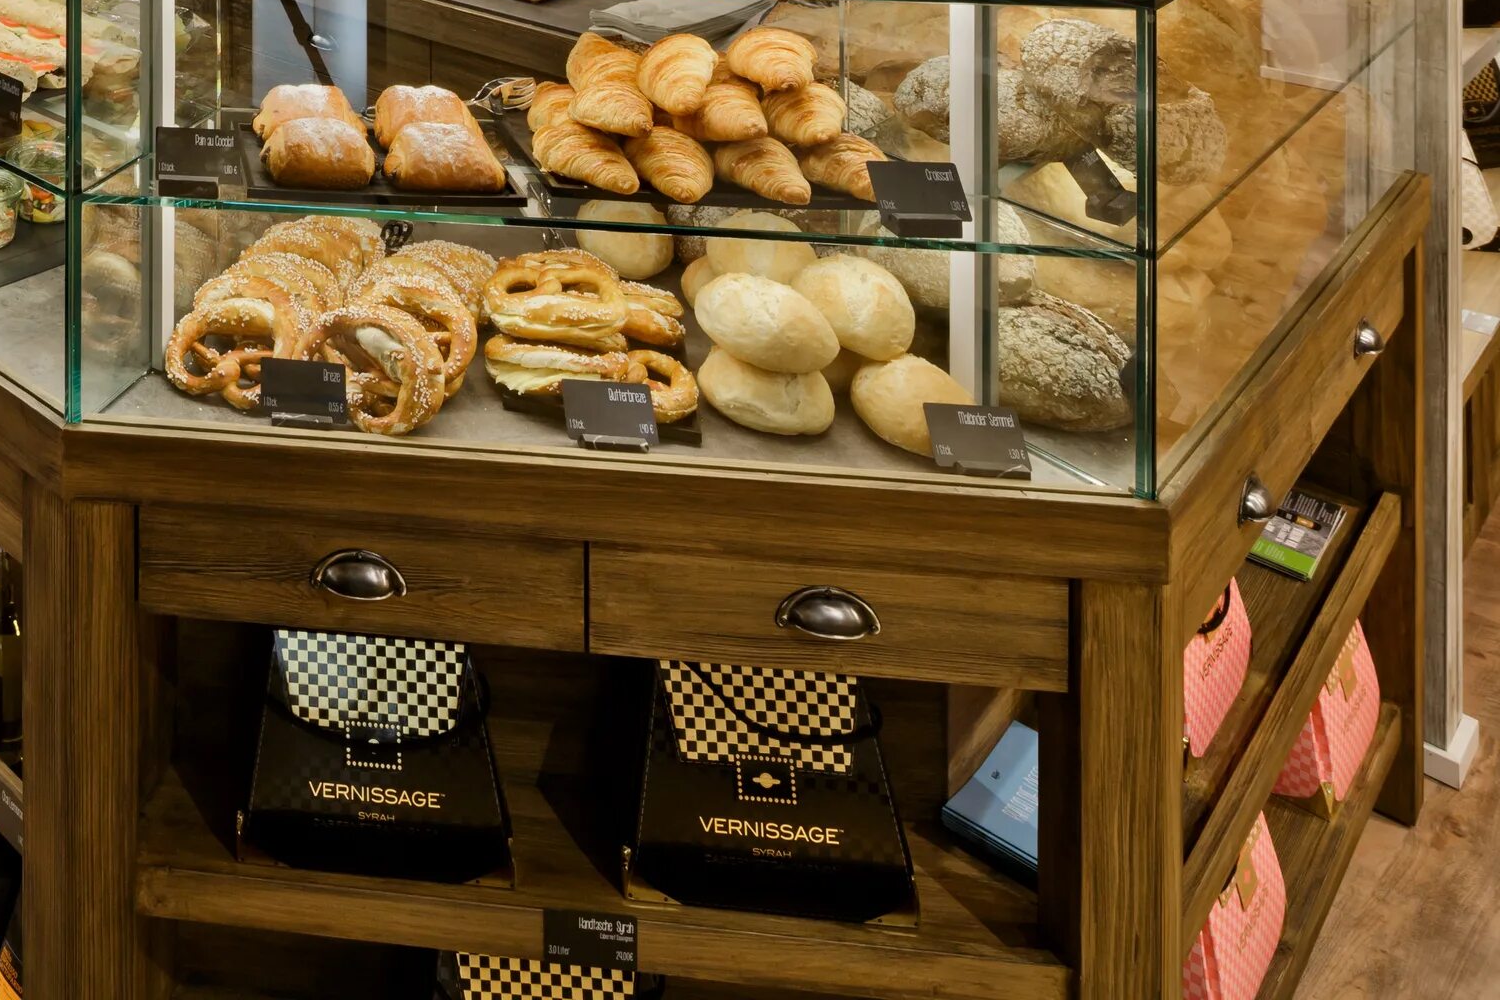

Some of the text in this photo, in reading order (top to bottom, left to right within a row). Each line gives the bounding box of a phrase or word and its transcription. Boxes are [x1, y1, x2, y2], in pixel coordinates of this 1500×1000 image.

[925, 168, 954, 182] Croissant
[323, 368, 340, 382] Breze
[608, 388, 647, 404] Butterbreze
[988, 413, 1014, 428] Semmel
[358, 812, 395, 822] SYRAH
[752, 848, 792, 858] SYRAH
[578, 916, 634, 935] Handtasche Syrah
[557, 946, 570, 956] Liter
